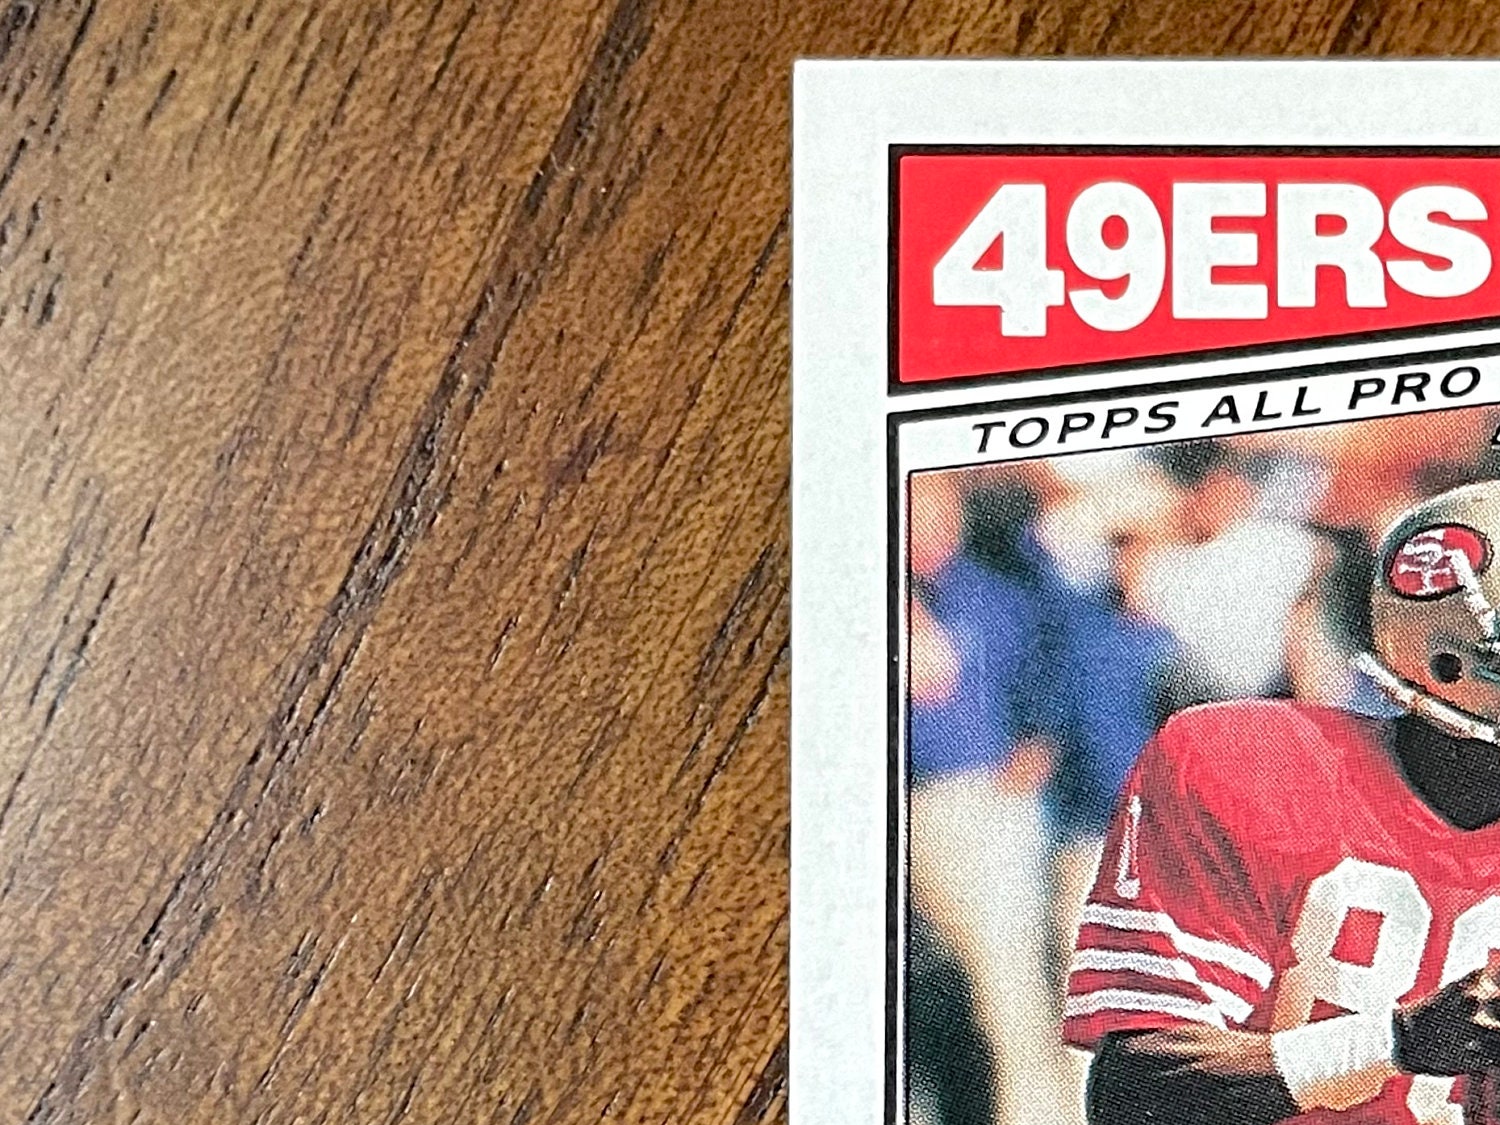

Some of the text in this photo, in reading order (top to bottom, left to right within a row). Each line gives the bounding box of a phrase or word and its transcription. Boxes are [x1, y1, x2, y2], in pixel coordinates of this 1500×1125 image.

[932, 181, 1493, 337] 49ERS
[971, 365, 1482, 455] TOPPS ALL PRO
